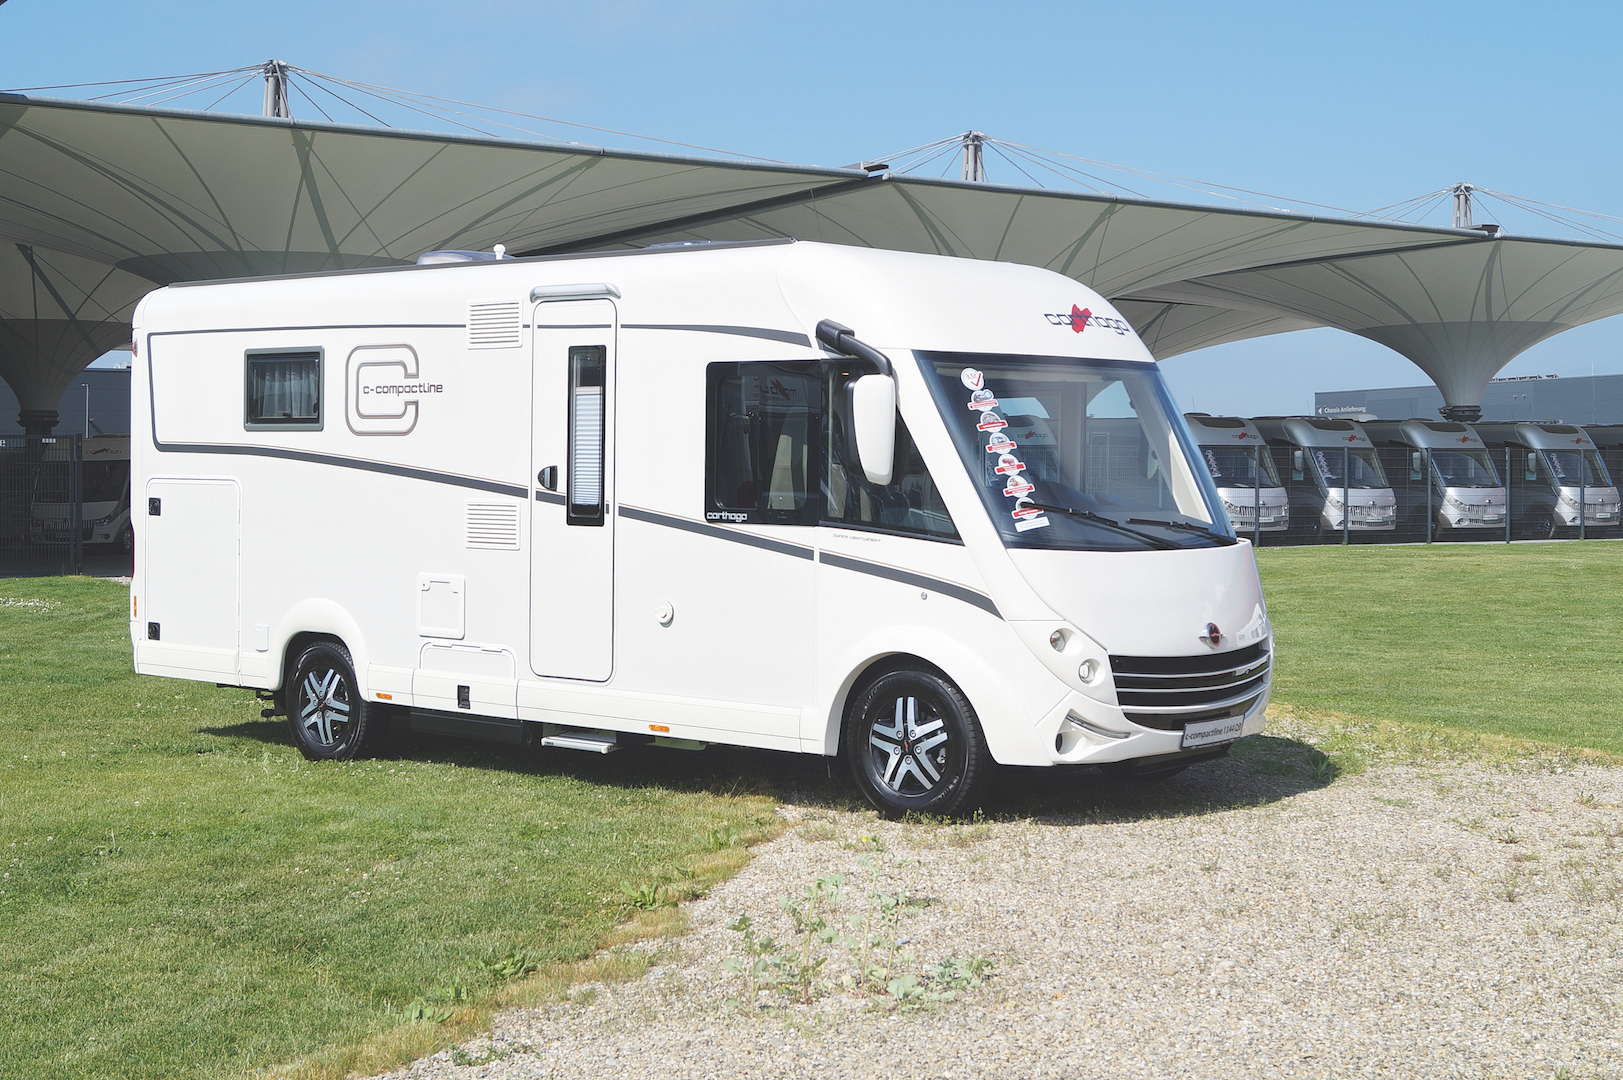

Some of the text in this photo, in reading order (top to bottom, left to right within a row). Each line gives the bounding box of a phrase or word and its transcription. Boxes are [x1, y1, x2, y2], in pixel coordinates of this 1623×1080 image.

[363, 383, 443, 397] c-compactline
[1341, 405, 1366, 413] Anlieferung
[706, 511, 748, 523] carthago
[1185, 727, 1223, 740] c-compactline
